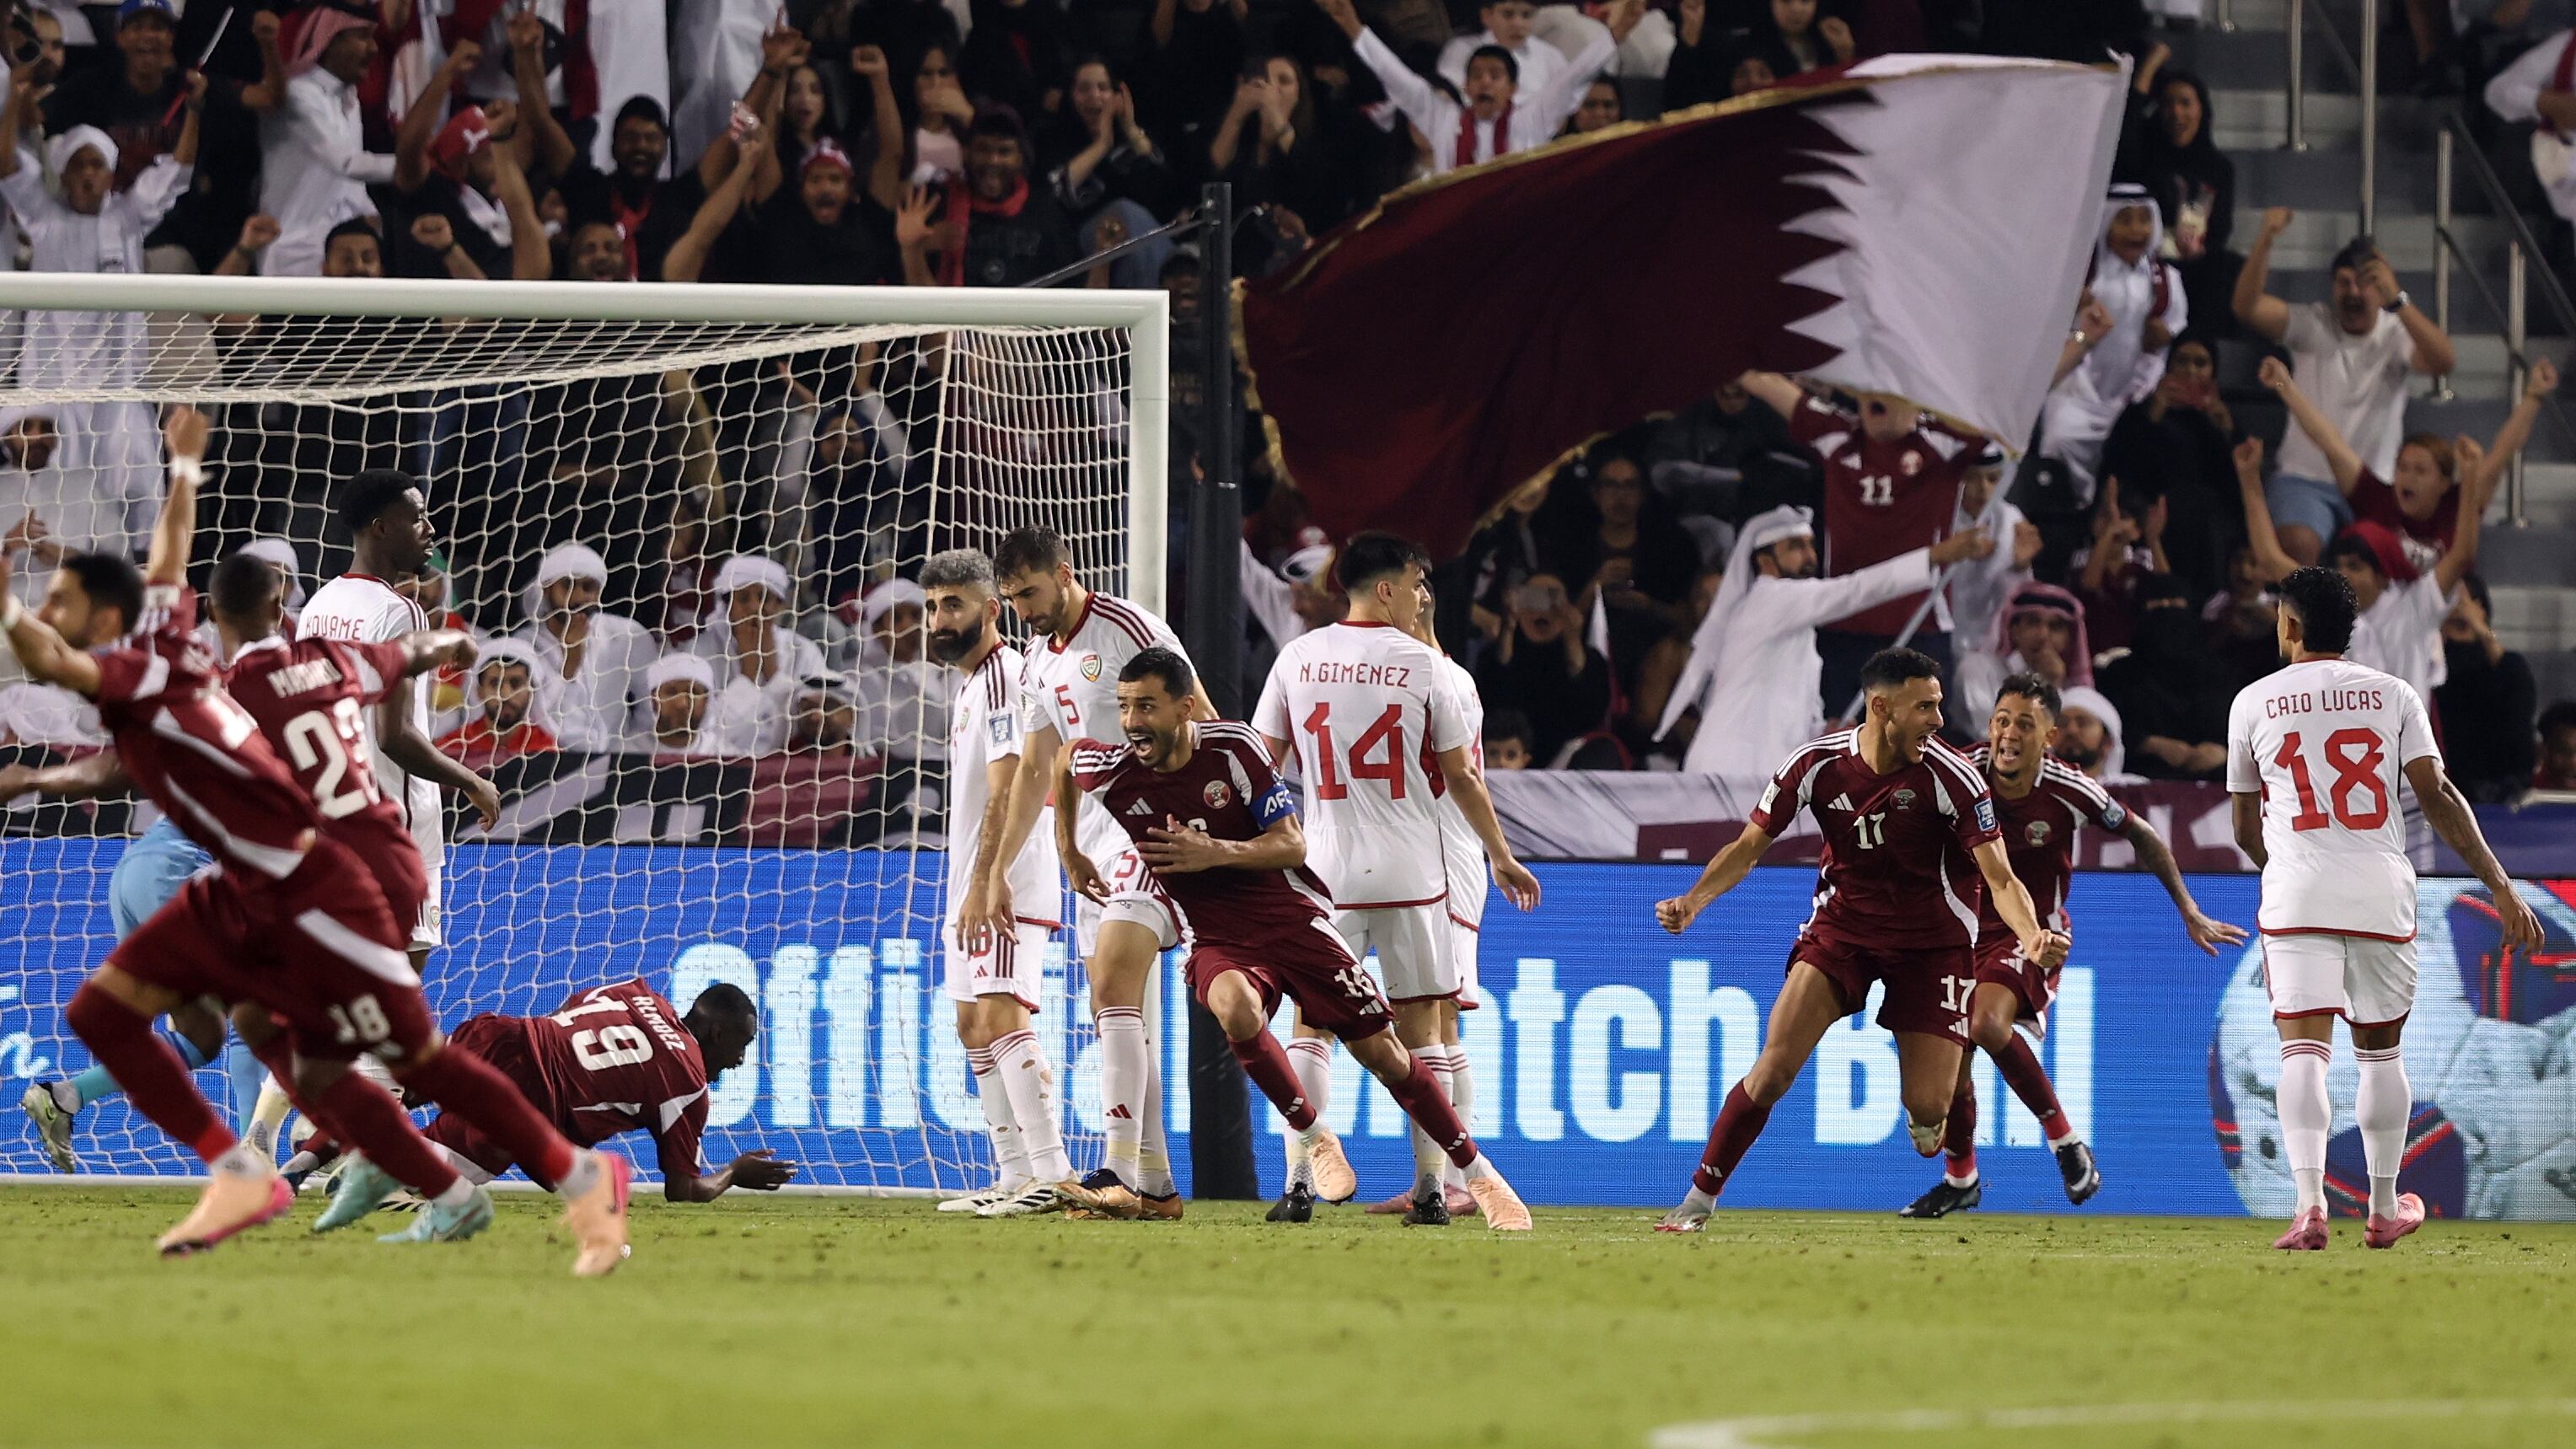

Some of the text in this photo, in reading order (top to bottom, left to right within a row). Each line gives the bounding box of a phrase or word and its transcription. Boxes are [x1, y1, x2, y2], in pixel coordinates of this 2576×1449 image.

[1859, 475, 1895, 506] 11
[304, 614, 365, 641] KOUAME
[1300, 663, 1410, 688] N.GIMENEZ
[1055, 684, 1080, 725] 5
[2266, 690, 2383, 719] CAIO LUCAS
[1303, 702, 1406, 800] 14
[2273, 727, 2389, 832] 18
[1854, 812, 1886, 849] 17
[1114, 851, 1138, 878] 5
[1334, 963, 1377, 998] 16
[1940, 974, 1977, 1014] 17
[328, 995, 391, 1043] 18
[550, 996, 653, 1071] 19
[1815, 967, 2094, 1147] Bll
